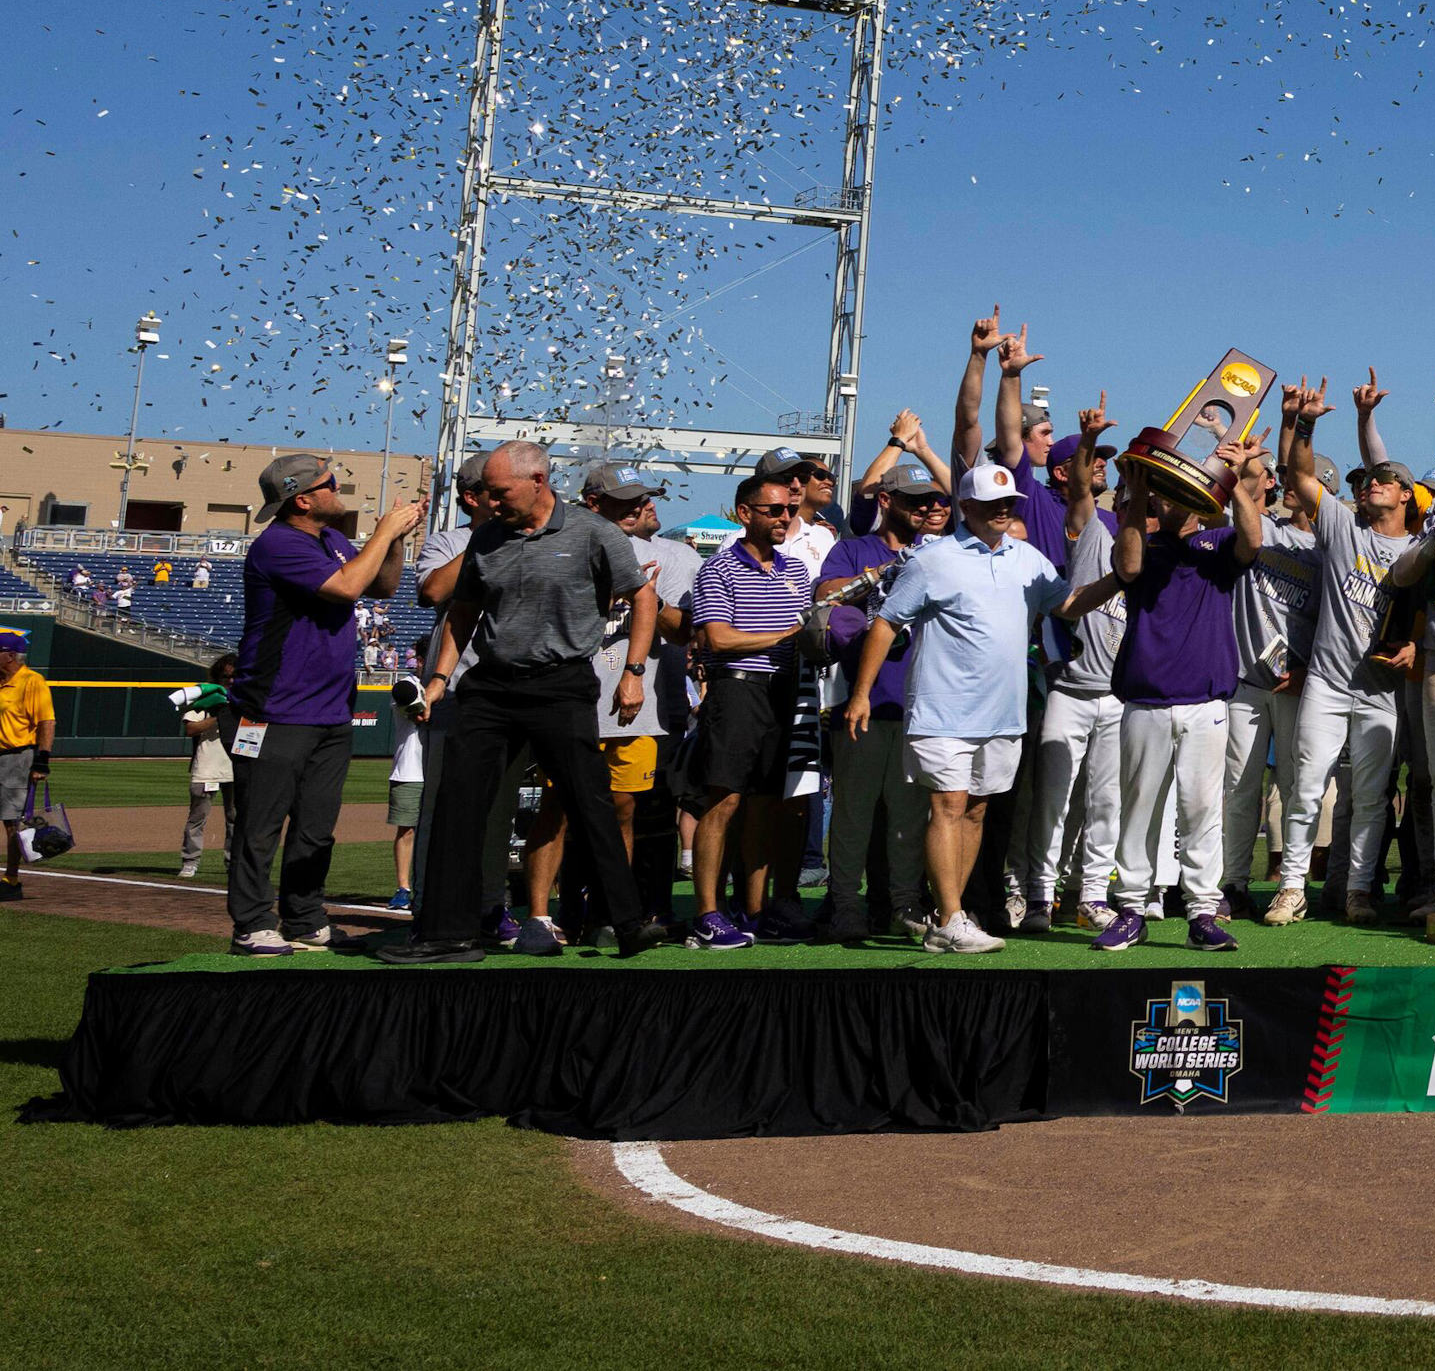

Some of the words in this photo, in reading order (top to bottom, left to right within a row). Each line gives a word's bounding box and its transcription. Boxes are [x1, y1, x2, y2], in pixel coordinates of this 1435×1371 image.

[1151, 449, 1181, 468] NATIONAL
[1179, 461, 1212, 486] CHAMPION
[215, 541, 235, 552] 127
[361, 718, 378, 727] DIRT
[643, 771, 656, 780] LS
[1176, 998, 1202, 1006] NCAA
[1174, 1027, 1199, 1035] MEN'S
[1156, 1035, 1218, 1052] COLLEGE
[1134, 1052, 1183, 1070] WORLD
[1186, 1052, 1239, 1069] SERIES
[1169, 1070, 1201, 1078] OMAHA
